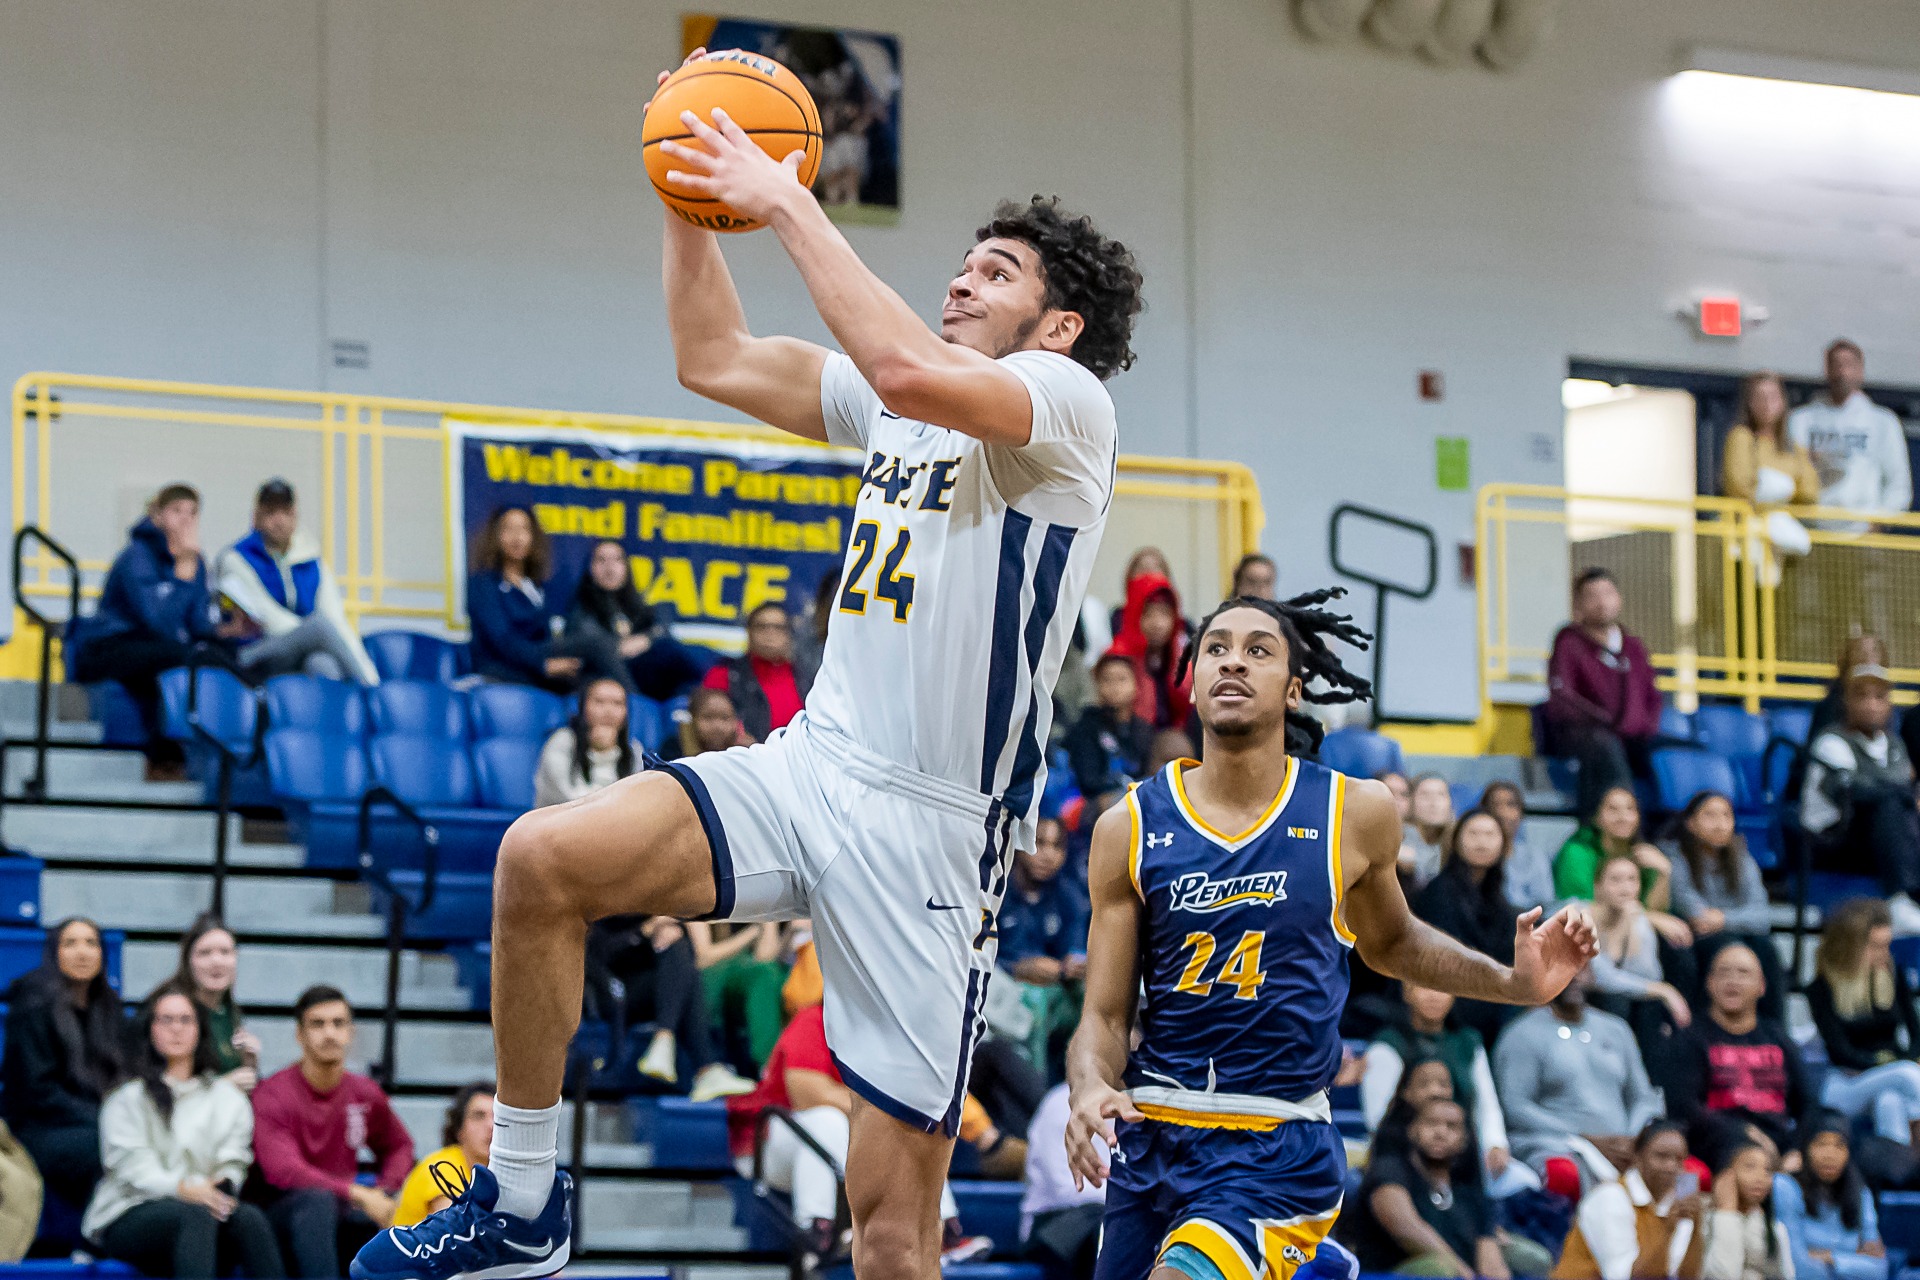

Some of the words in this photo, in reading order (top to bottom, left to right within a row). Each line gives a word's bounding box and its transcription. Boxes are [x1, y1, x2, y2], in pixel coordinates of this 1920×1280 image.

[484, 444, 693, 495] Welcome
[703, 460, 861, 507] Parent
[638, 502, 842, 553] Families!
[838, 519, 916, 624] 24
[1172, 930, 1267, 1001] 24
